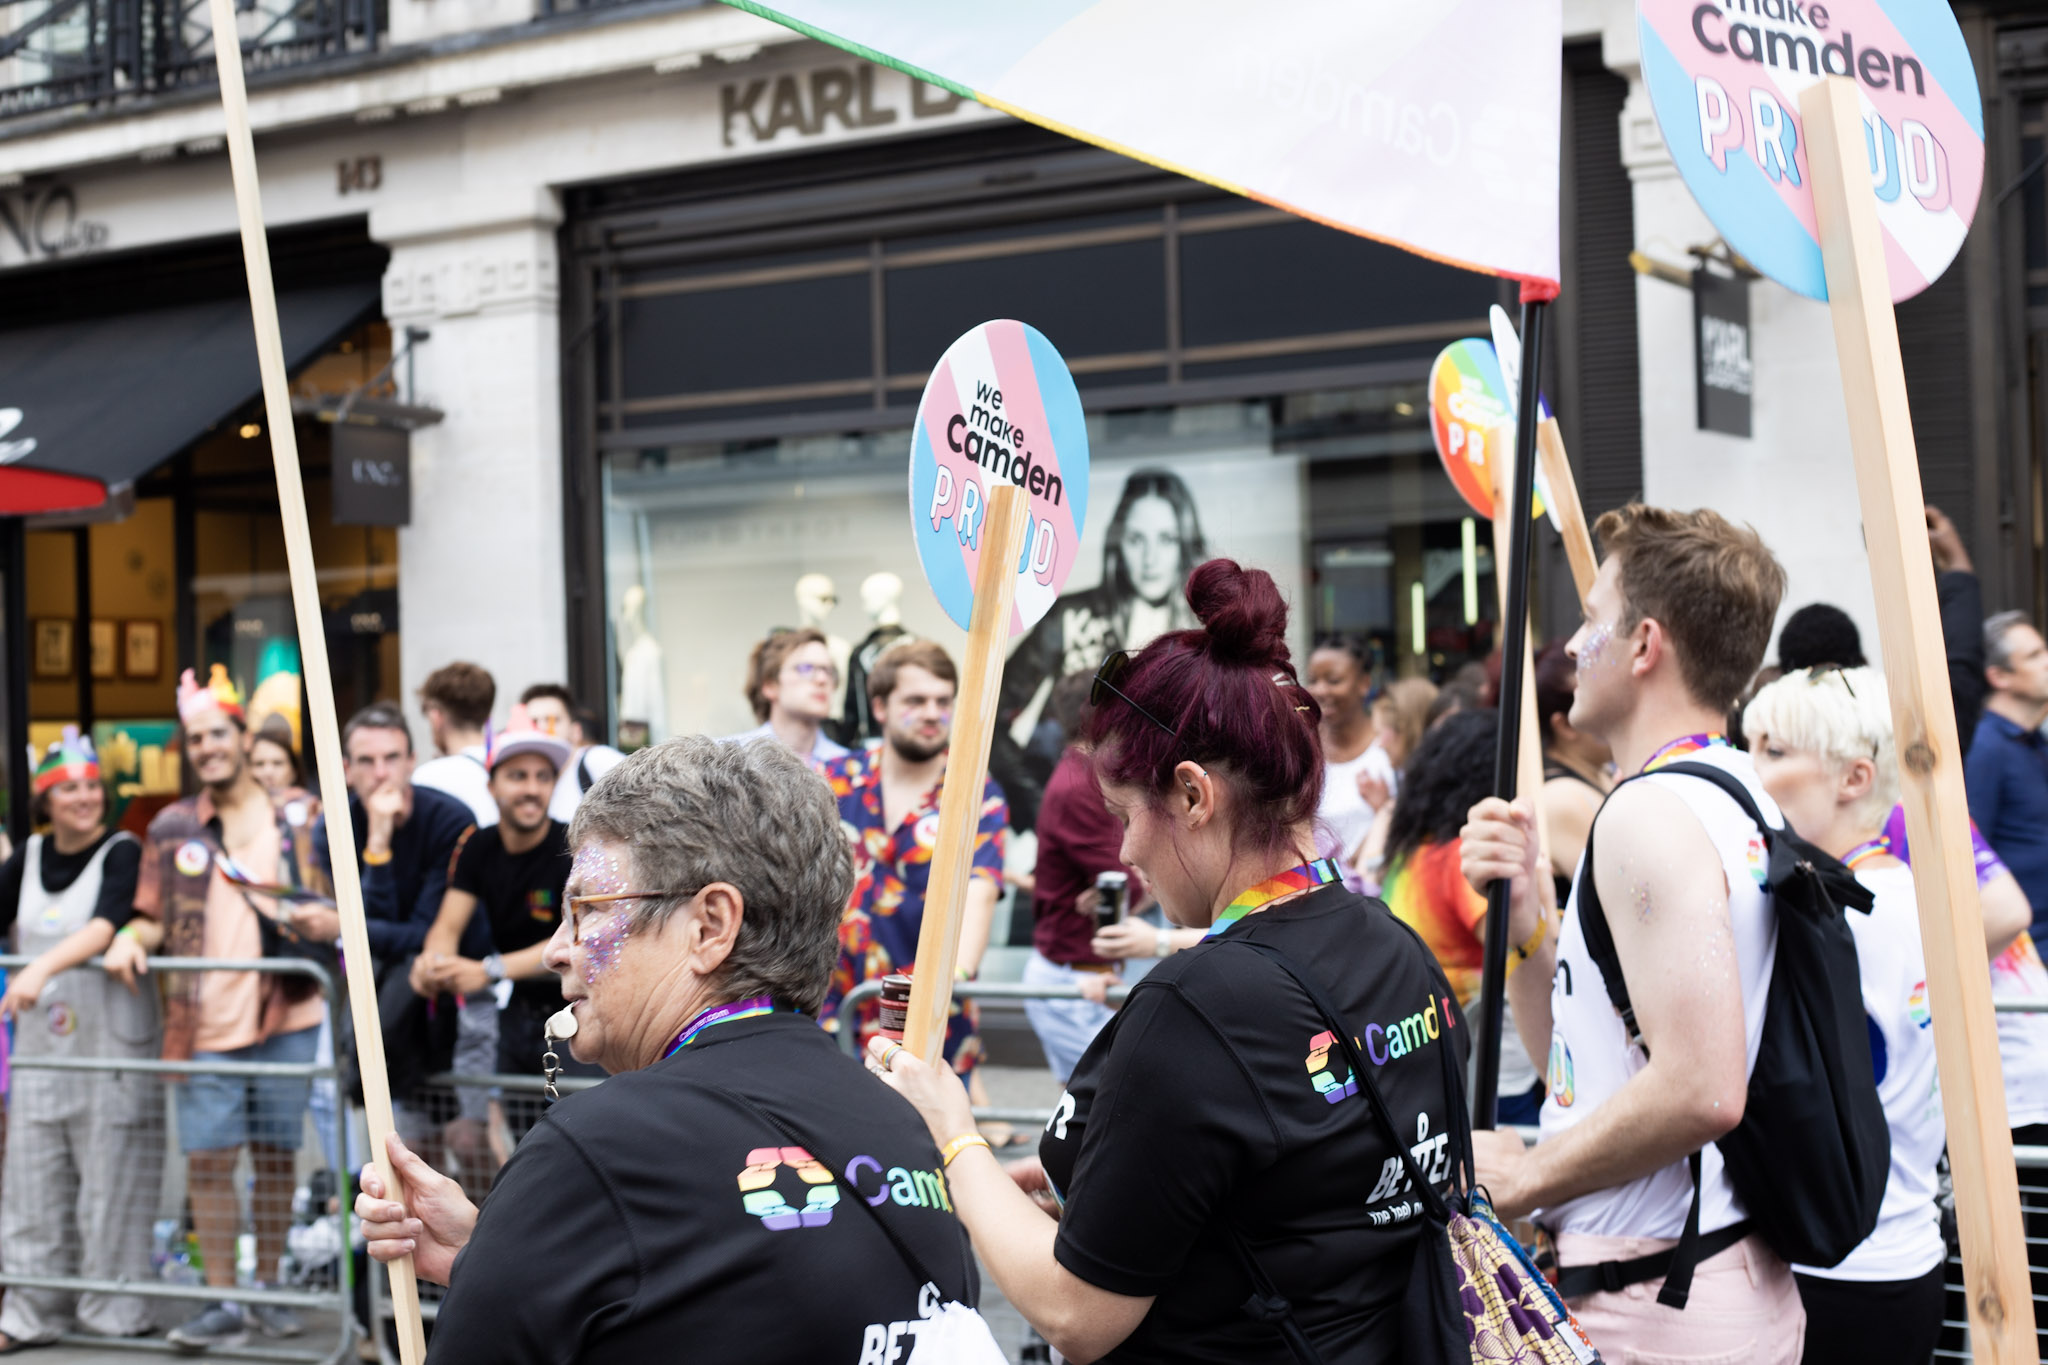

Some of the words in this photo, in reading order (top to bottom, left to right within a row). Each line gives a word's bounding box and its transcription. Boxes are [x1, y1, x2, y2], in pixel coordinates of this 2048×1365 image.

[1692, 4, 1926, 97] Camden
[722, 61, 897, 147] KARL
[1695, 76, 1952, 213] PRUD
[970, 404, 1024, 449] make
[976, 380, 1003, 410] we
[947, 414, 1063, 506] Camden
[930, 464, 1058, 586] PRD
[1365, 994, 1456, 1066] Camdn
